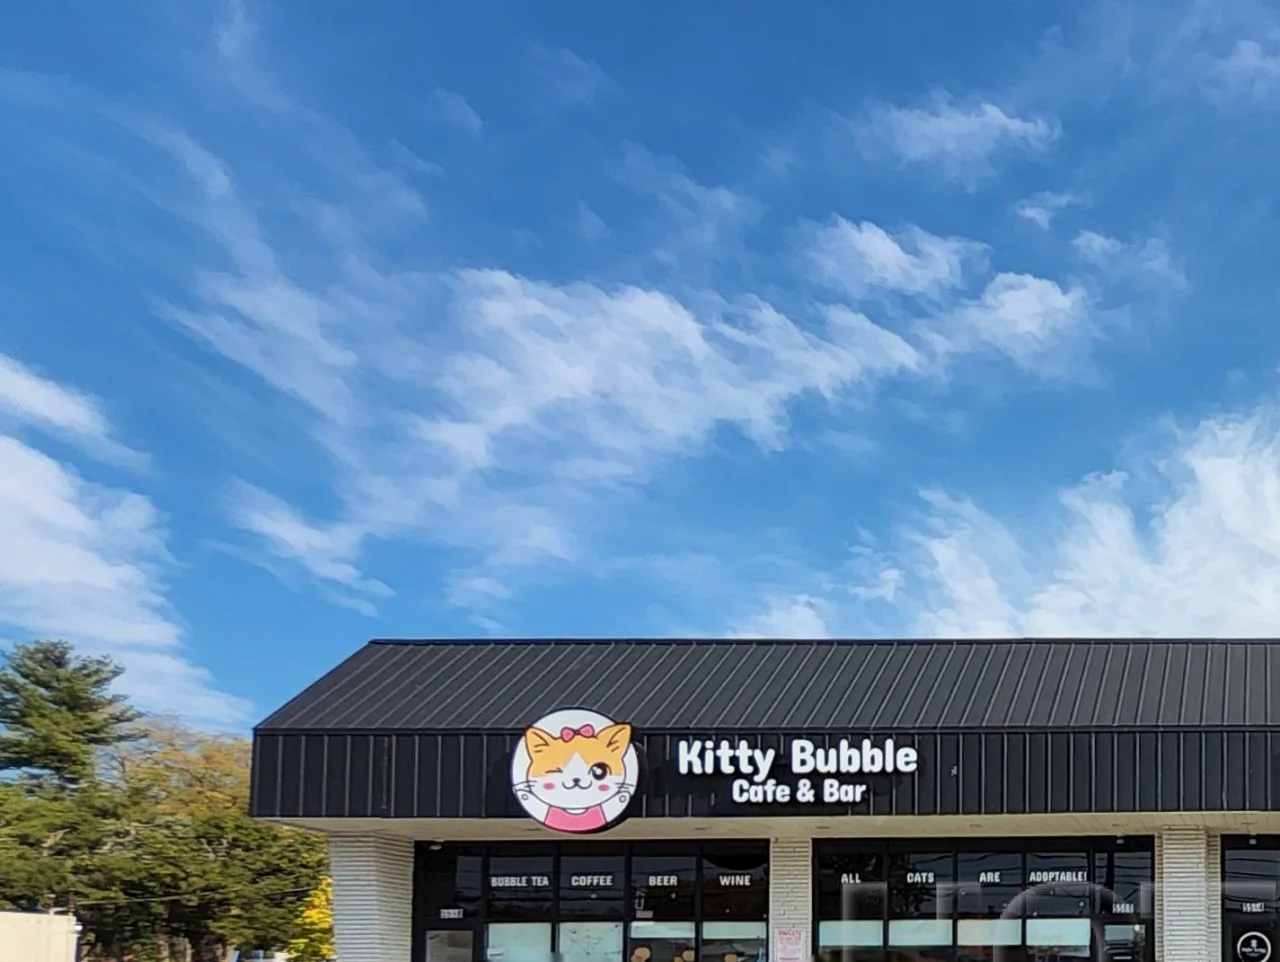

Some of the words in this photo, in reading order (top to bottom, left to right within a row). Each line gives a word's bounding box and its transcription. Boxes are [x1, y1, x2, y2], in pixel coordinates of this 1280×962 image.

[678, 739, 775, 782] Kitty
[791, 738, 917, 773] Bubble
[732, 779, 790, 803] Cafe
[796, 779, 815, 803] &
[823, 779, 866, 803] Bar
[490, 876, 528, 887] BUBBLE
[531, 876, 549, 887] TEA
[571, 875, 613, 886] COFFEE
[649, 875, 678, 886] BEER
[719, 875, 751, 886] WINE
[841, 873, 861, 883] ALL
[906, 872, 934, 883] CATS
[979, 872, 1000, 883] ARE
